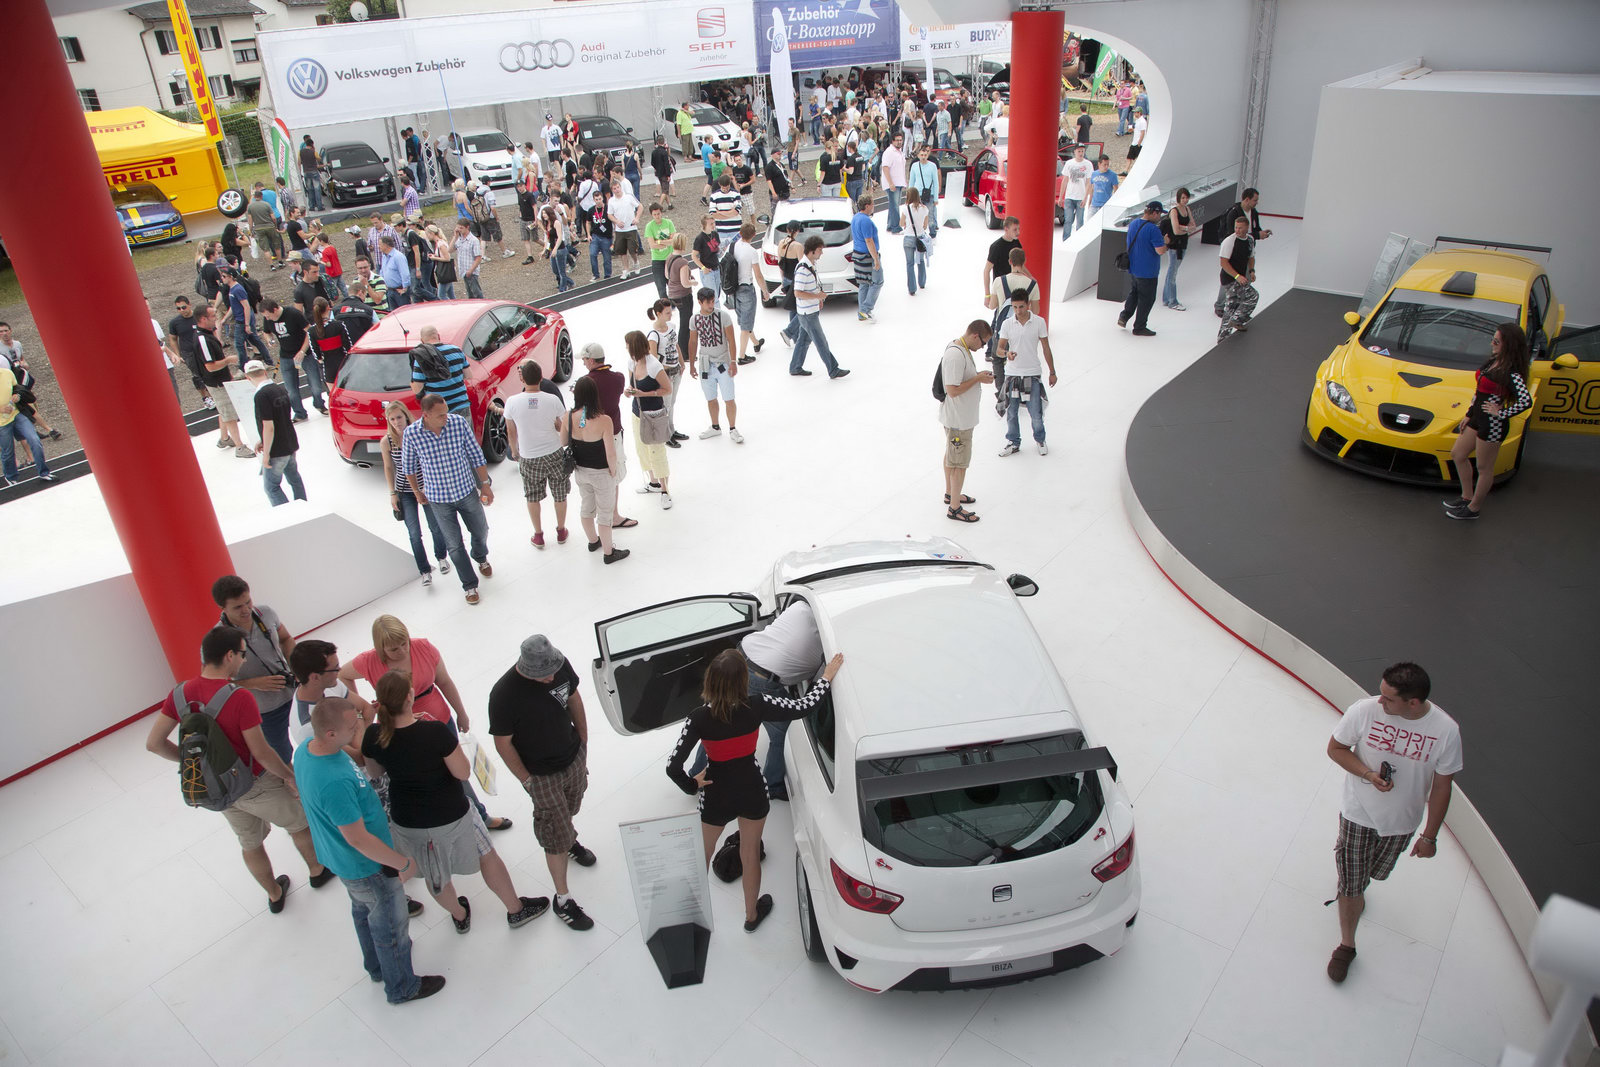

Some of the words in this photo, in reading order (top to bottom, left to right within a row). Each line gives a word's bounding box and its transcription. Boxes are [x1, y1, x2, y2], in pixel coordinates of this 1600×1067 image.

[787, 4, 840, 22] Zubehör
[766, 21, 876, 42] GI-Boxenstopp
[970, 29, 998, 42] BURY
[580, 42, 605, 53] Audi
[688, 40, 737, 52] SEAT
[788, 40, 836, 49] THERSEE-TOUR
[909, 41, 952, 52] SEERIT
[580, 51, 622, 63] Original
[624, 47, 667, 59] Zubehör
[334, 65, 412, 81] Volkswagen
[416, 58, 466, 73] Zubehör
[103, 157, 178, 188] IRELLI
[1541, 377, 1600, 415] 30
[991, 962, 1013, 972] IBIZA
